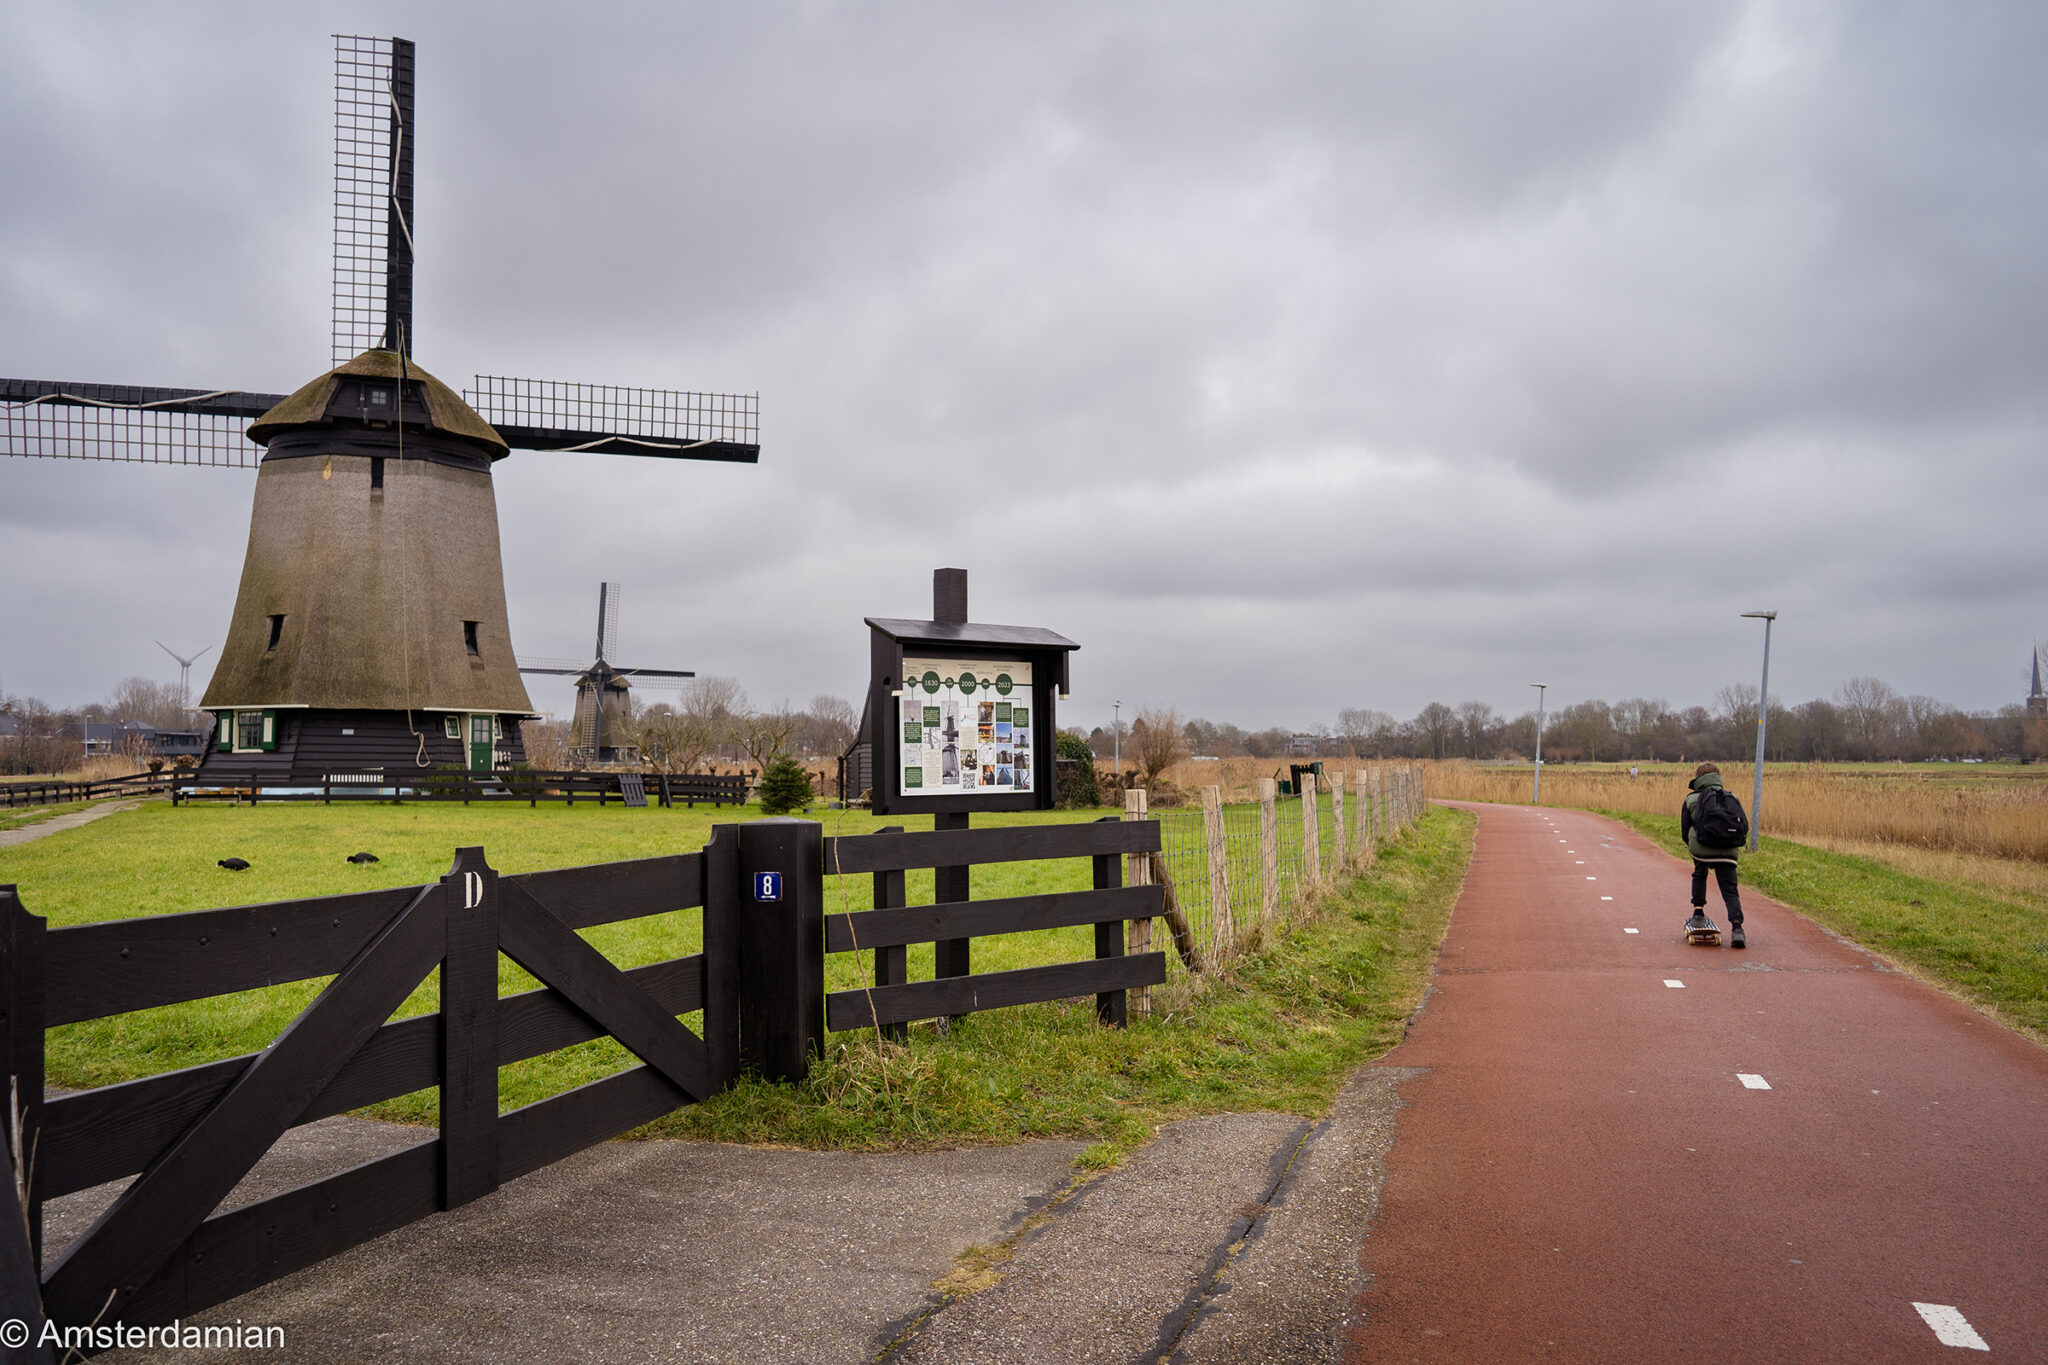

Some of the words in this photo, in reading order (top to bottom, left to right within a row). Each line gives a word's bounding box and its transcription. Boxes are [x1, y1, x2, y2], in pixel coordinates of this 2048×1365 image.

[961, 680, 975, 688] 2000
[464, 871, 483, 909] D
[763, 875, 772, 895] 8
